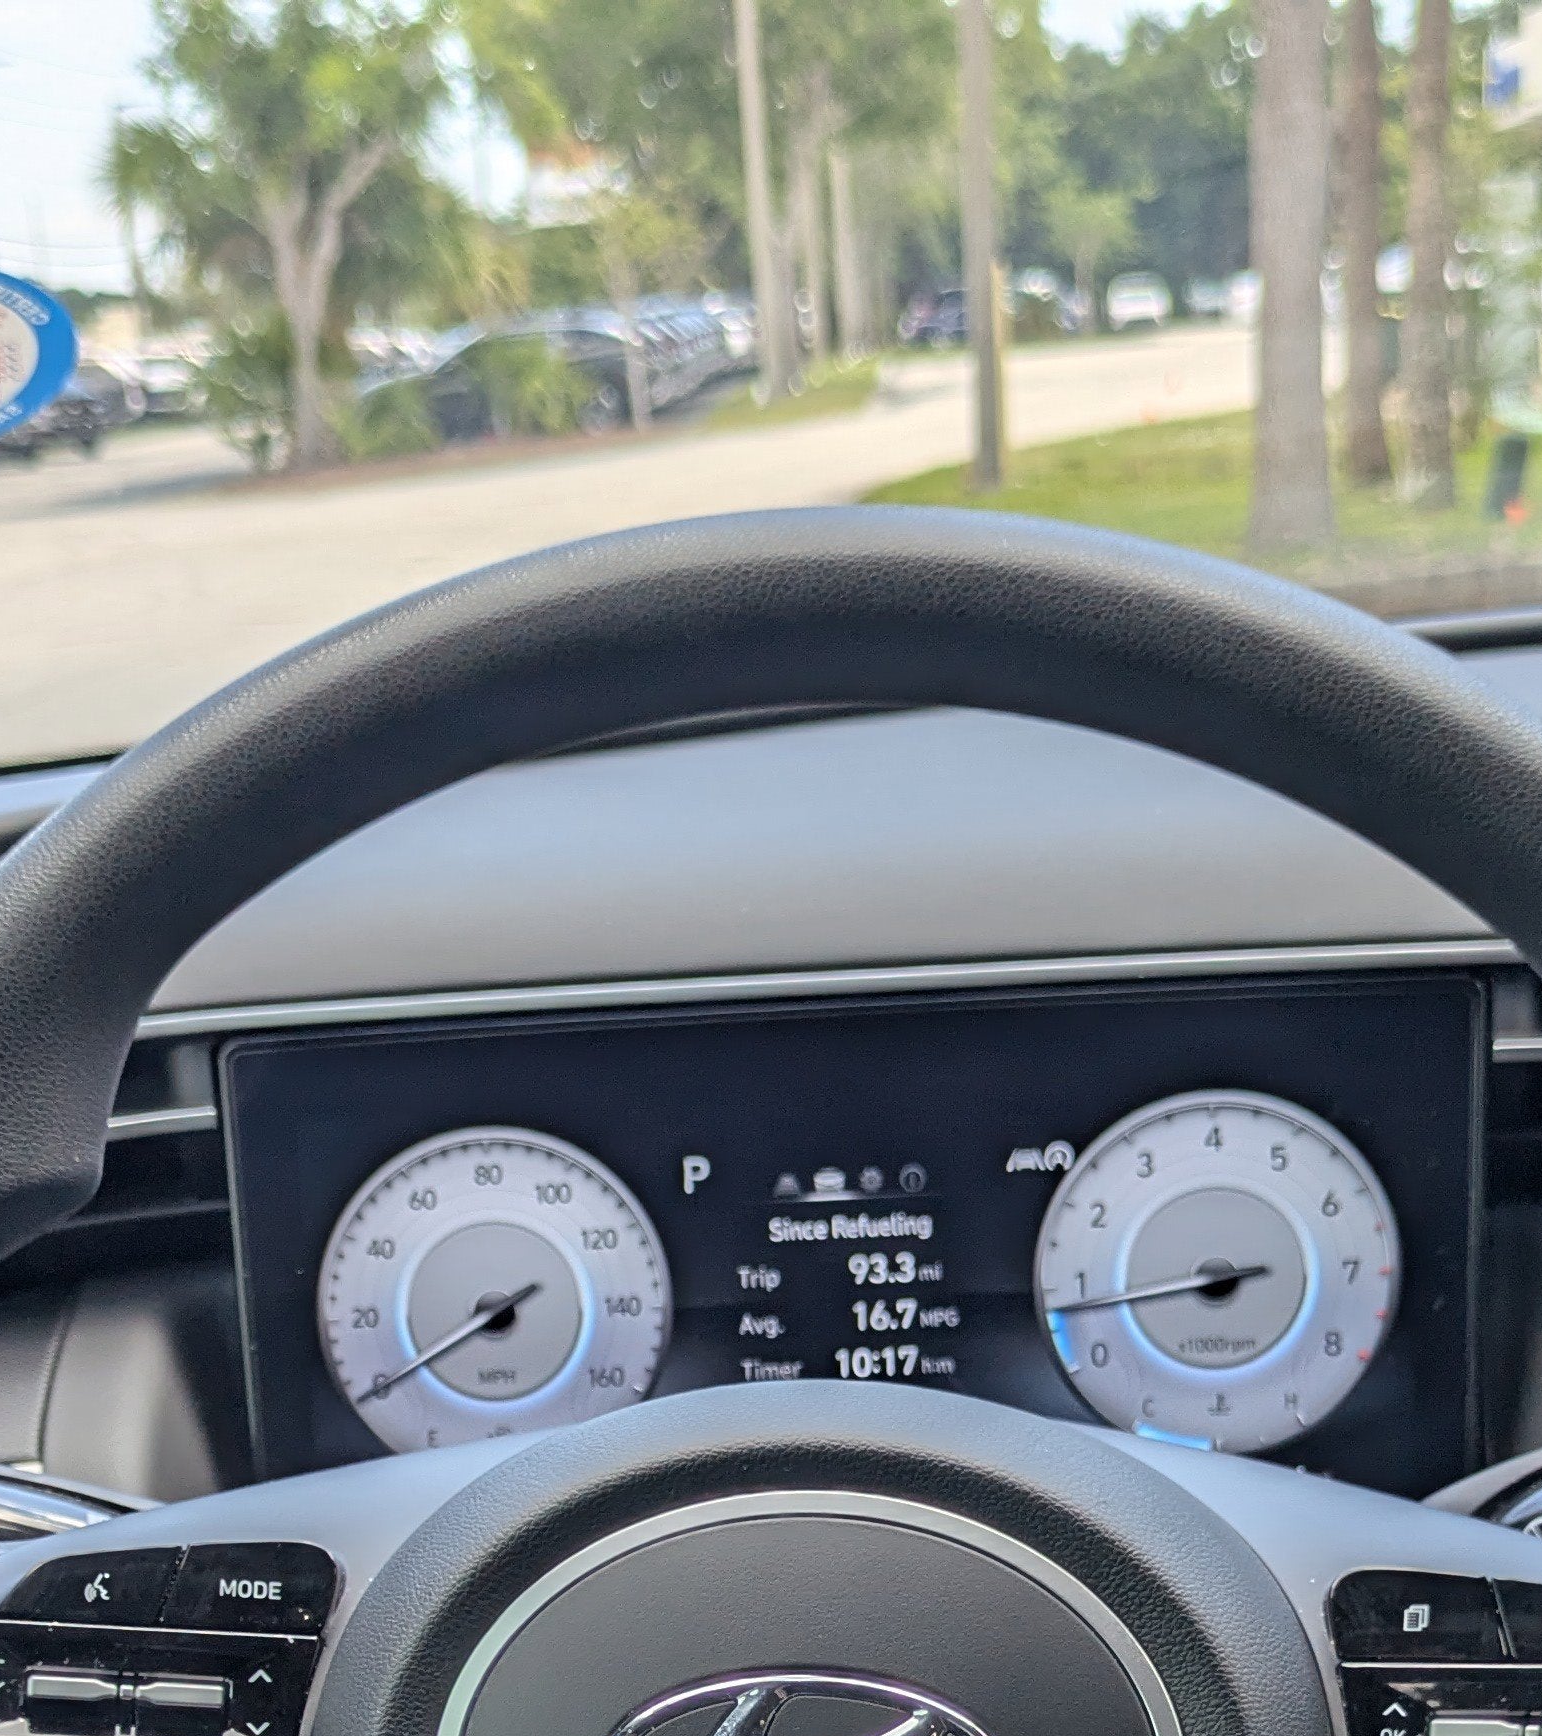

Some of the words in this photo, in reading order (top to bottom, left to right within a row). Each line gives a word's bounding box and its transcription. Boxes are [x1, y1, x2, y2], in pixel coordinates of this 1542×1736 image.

[1204, 1127, 1222, 1152] 4
[1135, 1153, 1155, 1178] 3
[1270, 1146, 1288, 1172] 5
[474, 1164, 503, 1186] 80
[682, 1155, 711, 1195] P
[409, 1189, 438, 1211] 60
[535, 1183, 572, 1205] 100
[1322, 1191, 1342, 1217] 6
[768, 1216, 828, 1243] Since
[831, 1212, 933, 1240] Refueling
[1090, 1203, 1108, 1229] 2
[366, 1239, 395, 1260] 40
[581, 1229, 617, 1250] 120
[736, 1264, 782, 1292] Trip
[847, 1251, 917, 1286] 93.3
[918, 1262, 942, 1282] mi
[1075, 1272, 1087, 1296] 1
[1342, 1260, 1360, 1285] 7
[353, 1308, 379, 1329] 20
[606, 1297, 641, 1318] 140
[739, 1313, 785, 1339] Avg.
[852, 1297, 917, 1331] 16.7
[919, 1307, 961, 1329] MPG
[1091, 1343, 1109, 1369] 0
[1324, 1331, 1343, 1357] 8
[740, 1358, 803, 1380] Timer
[834, 1345, 919, 1379] 10:17
[589, 1367, 625, 1389] 160
[219, 1578, 283, 1602] MODE
